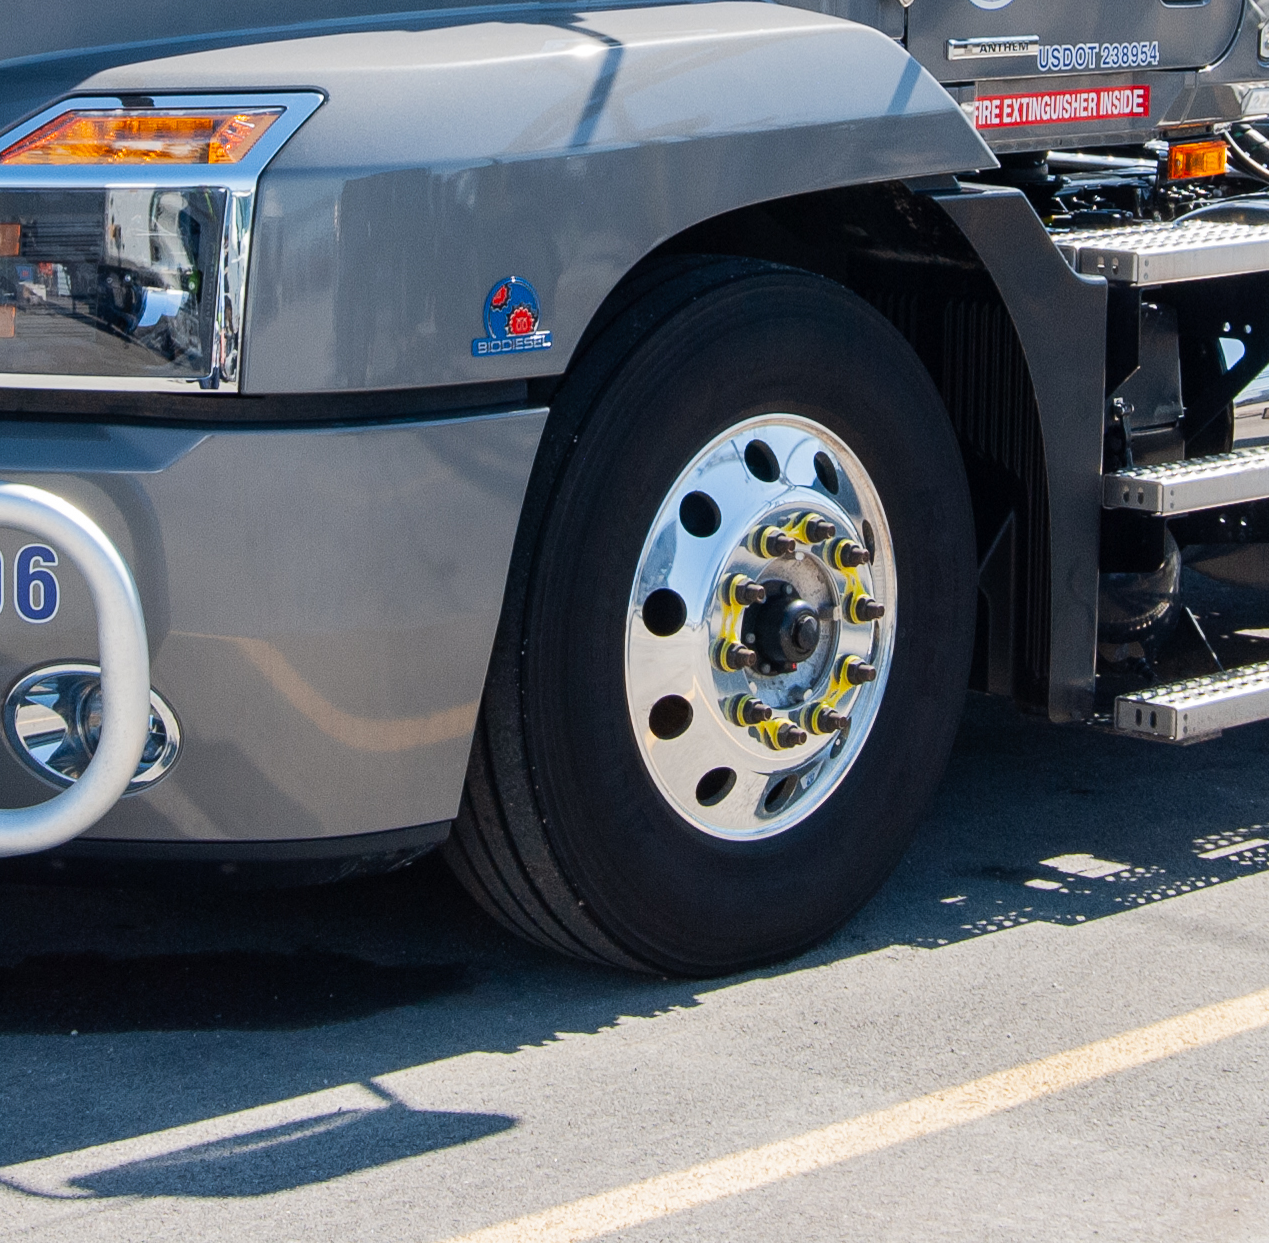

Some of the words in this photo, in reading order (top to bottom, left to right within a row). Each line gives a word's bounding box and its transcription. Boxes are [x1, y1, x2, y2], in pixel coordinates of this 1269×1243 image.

[979, 42, 1029, 53] ANTHEM
[1037, 43, 1099, 71] USDOT
[1101, 41, 1159, 68] 238954
[974, 96, 1001, 125] FIRE
[1002, 89, 1097, 123] EXTINGUISHER
[1099, 88, 1144, 115] INSIDE
[478, 335, 550, 354] BIODIESEL
